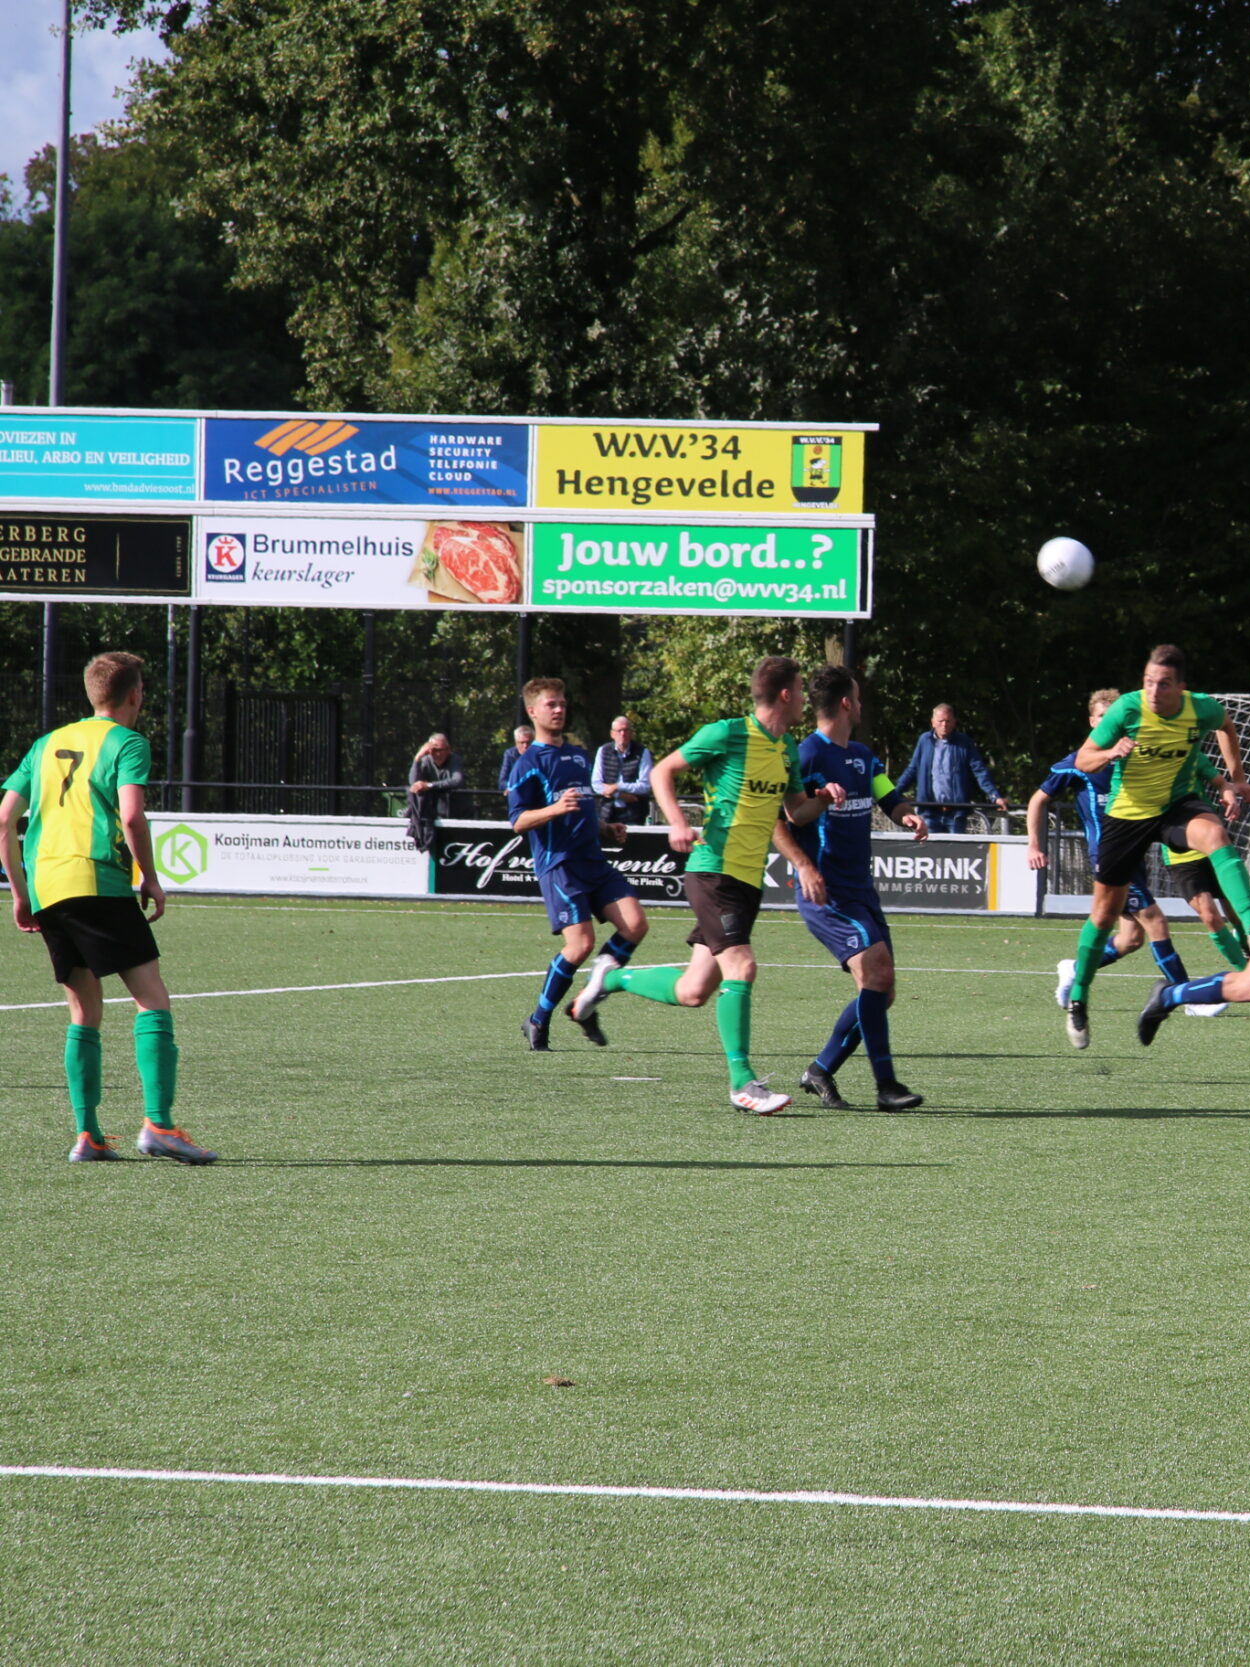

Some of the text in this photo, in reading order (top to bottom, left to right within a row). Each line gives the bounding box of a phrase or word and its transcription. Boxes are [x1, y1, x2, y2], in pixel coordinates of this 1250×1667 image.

[60, 432, 77, 445] IN
[429, 435, 503, 445] HARDWARE
[42, 450, 81, 464] ARBO
[85, 451, 104, 464] EN
[108, 452, 190, 466] VEILIGHEID
[429, 447, 491, 457] SECURITY
[224, 444, 396, 486] Reggestad
[429, 459, 498, 469] TELEFONIE
[428, 472, 472, 481] CLOUD
[556, 469, 775, 505] Hengevelde
[244, 481, 377, 500] ICT SPECIALISTEN
[0, 547, 87, 563] GEBRANDE
[253, 534, 414, 557] Brummelhuis
[557, 531, 833, 572] Jouw bord..?
[251, 562, 355, 589] keurslager
[542, 575, 847, 602] sponsorzaken@wvv34.nl
[55, 749, 84, 807] 7
[215, 833, 416, 851] Kooijman Automotive dienste
[439, 835, 523, 889] Hof
[870, 856, 983, 880] NBRINK
